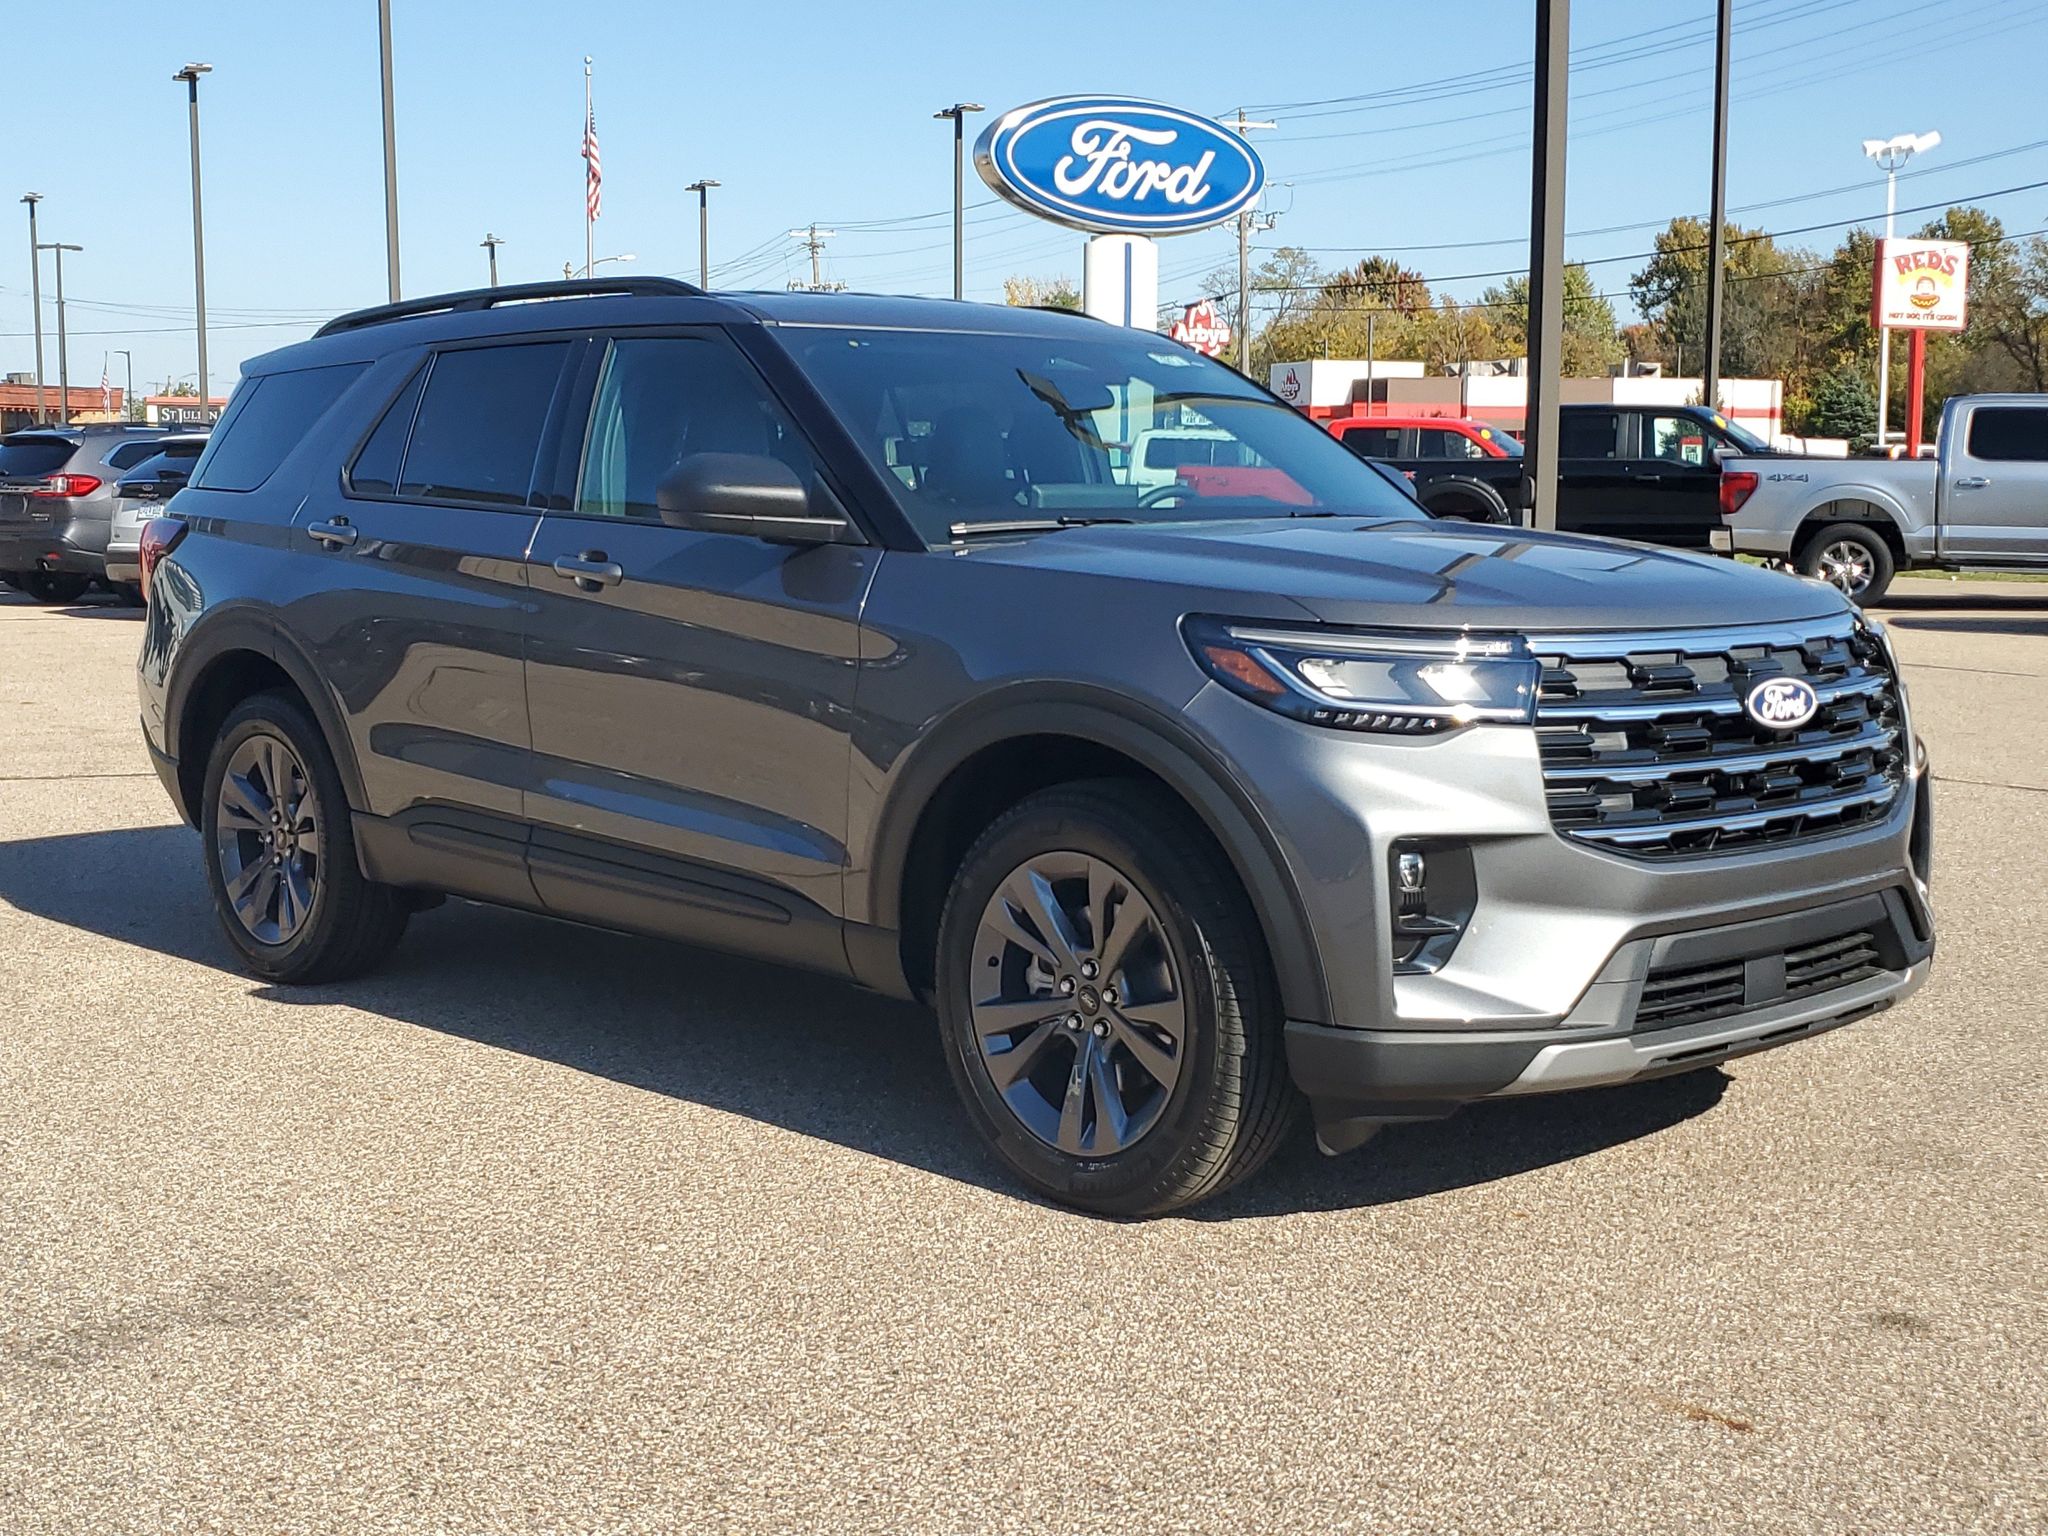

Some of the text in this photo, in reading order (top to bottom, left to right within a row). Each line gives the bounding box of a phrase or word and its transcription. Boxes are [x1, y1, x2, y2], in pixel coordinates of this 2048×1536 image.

[1054, 120, 1216, 205] Ford
[1894, 248, 1959, 276] RED'S
[1174, 322, 1231, 348] Arby's
[177, 408, 218, 424] JULIN
[1762, 685, 1807, 721] Ford
